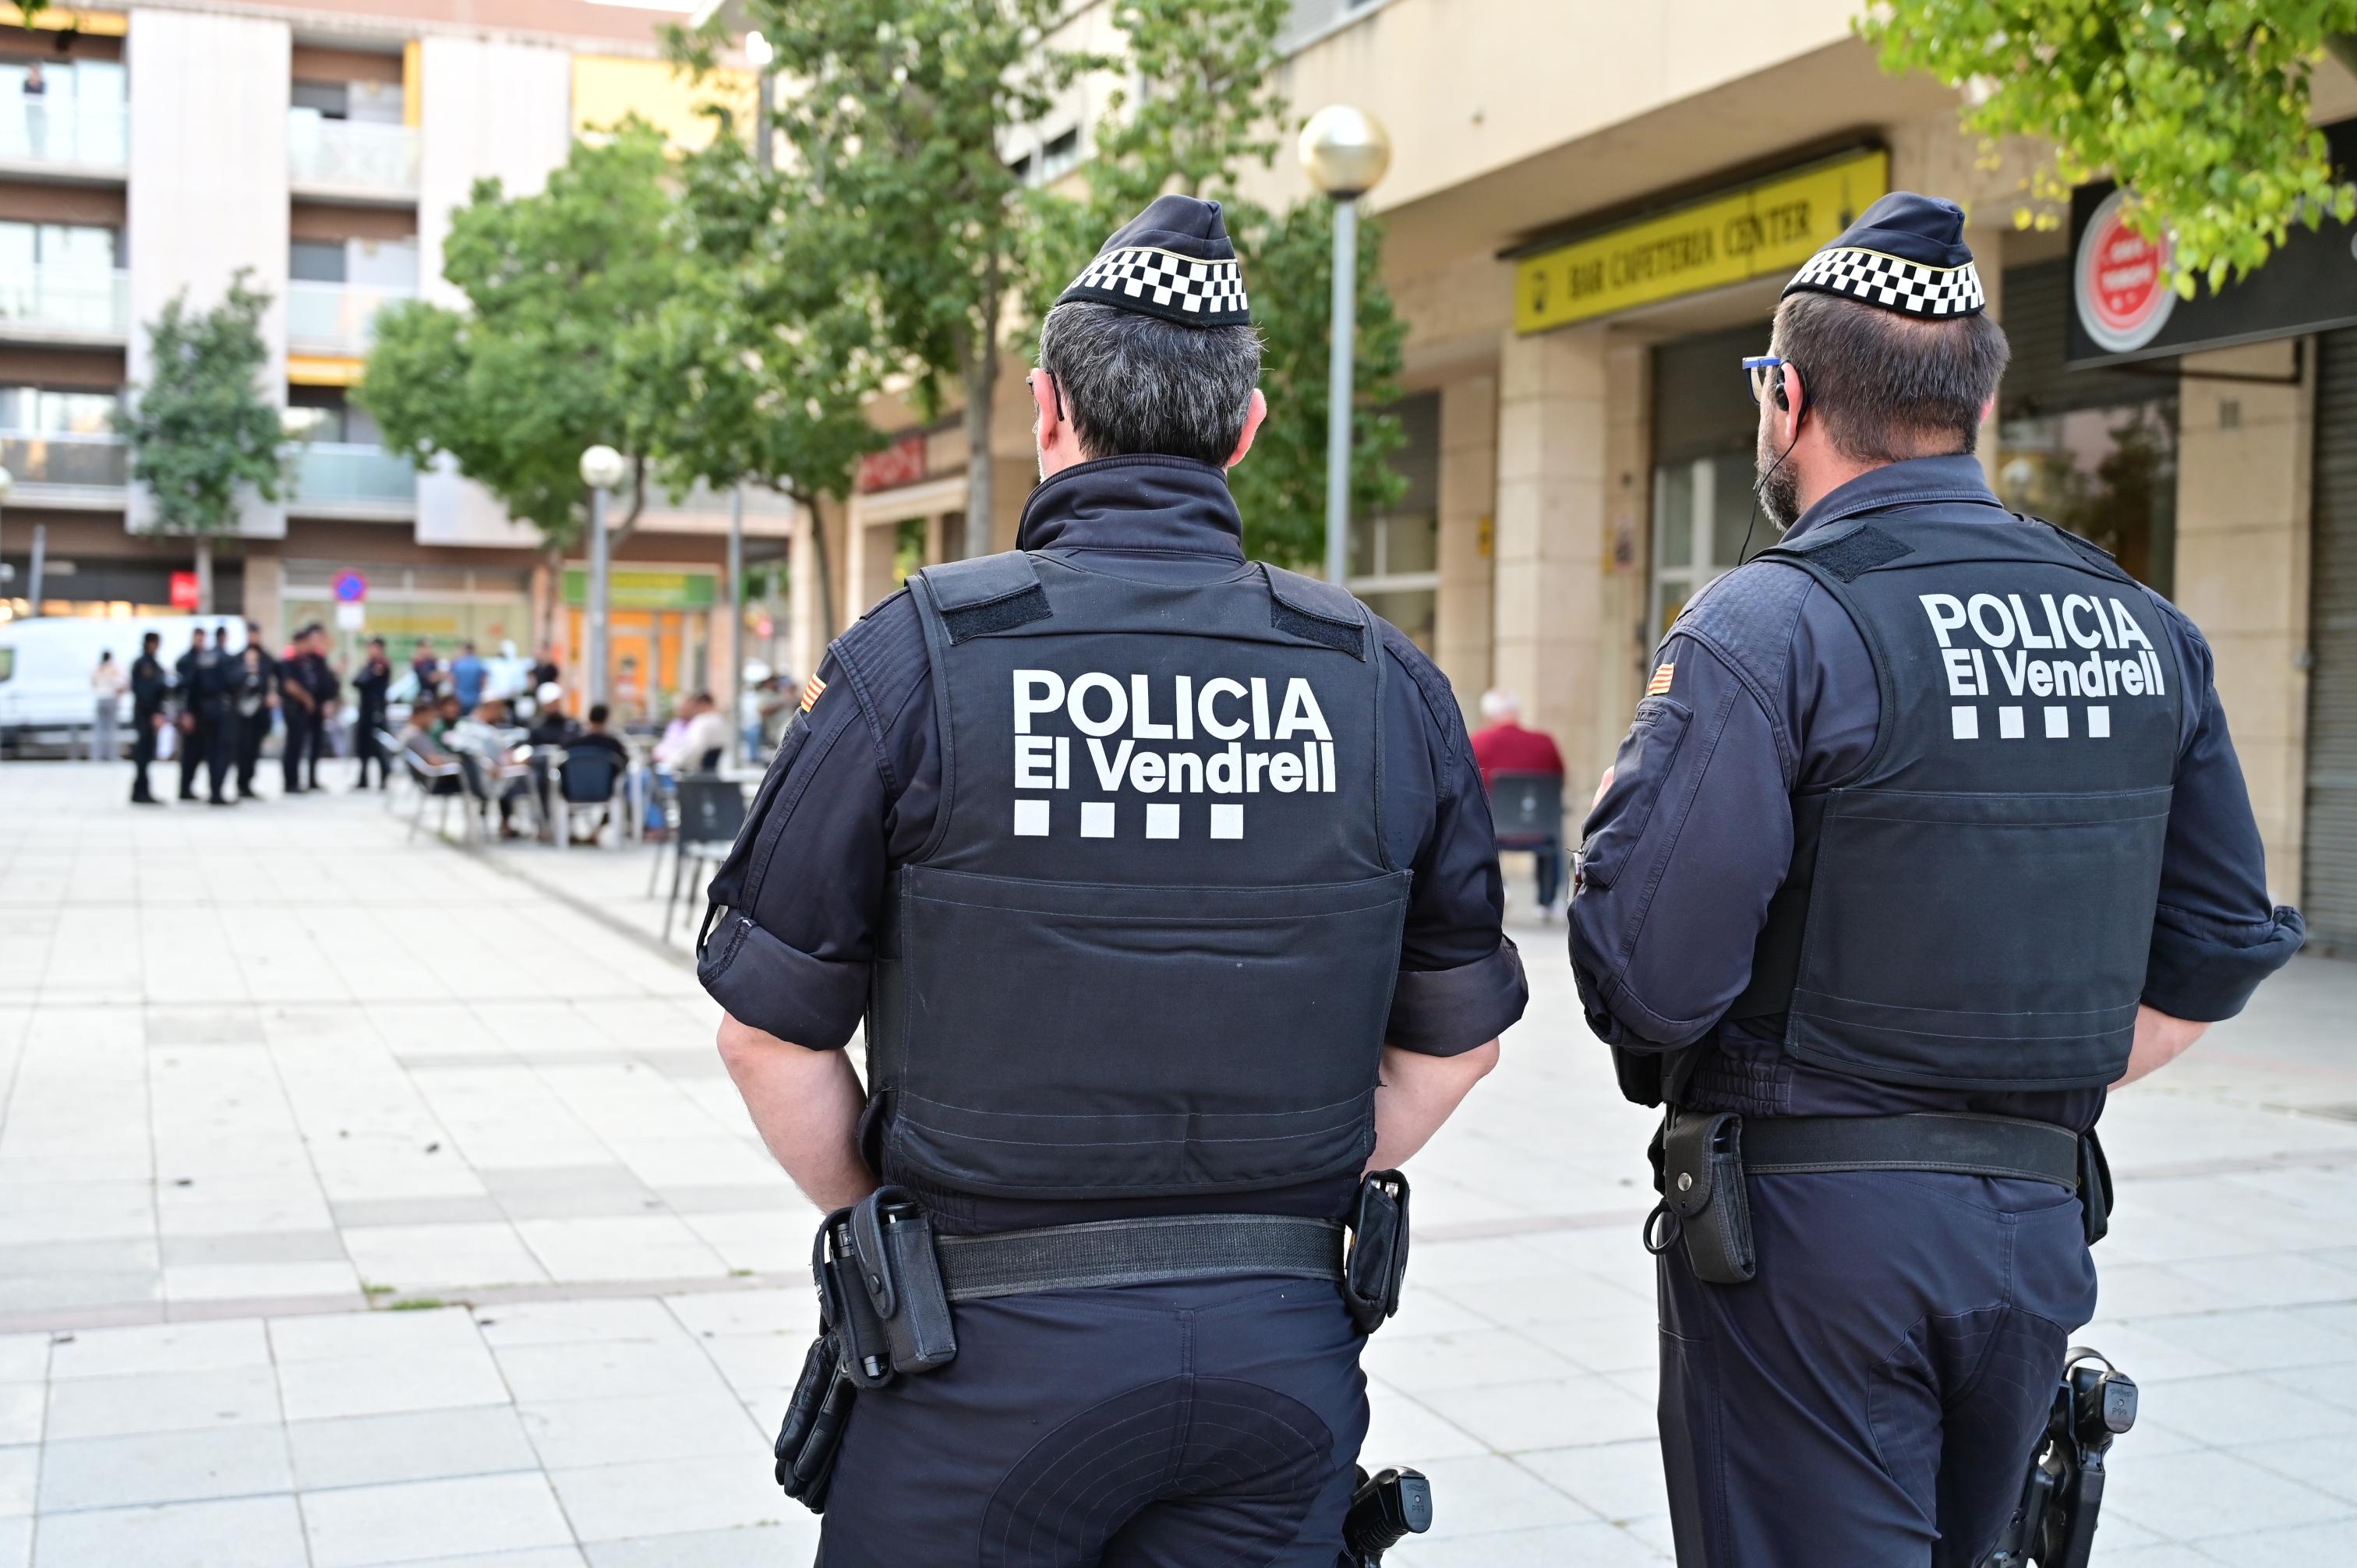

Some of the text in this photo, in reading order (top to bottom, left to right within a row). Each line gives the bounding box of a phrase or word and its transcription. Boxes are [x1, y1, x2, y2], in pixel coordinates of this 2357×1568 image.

[1570, 201, 1811, 299] BAR CAFETERIA CENTER
[1918, 593, 2154, 650] POLICIA
[1941, 648, 2165, 697] El Vendrell
[1012, 669, 1333, 741] POLICIA
[1014, 736, 1336, 794] El Vendrell
